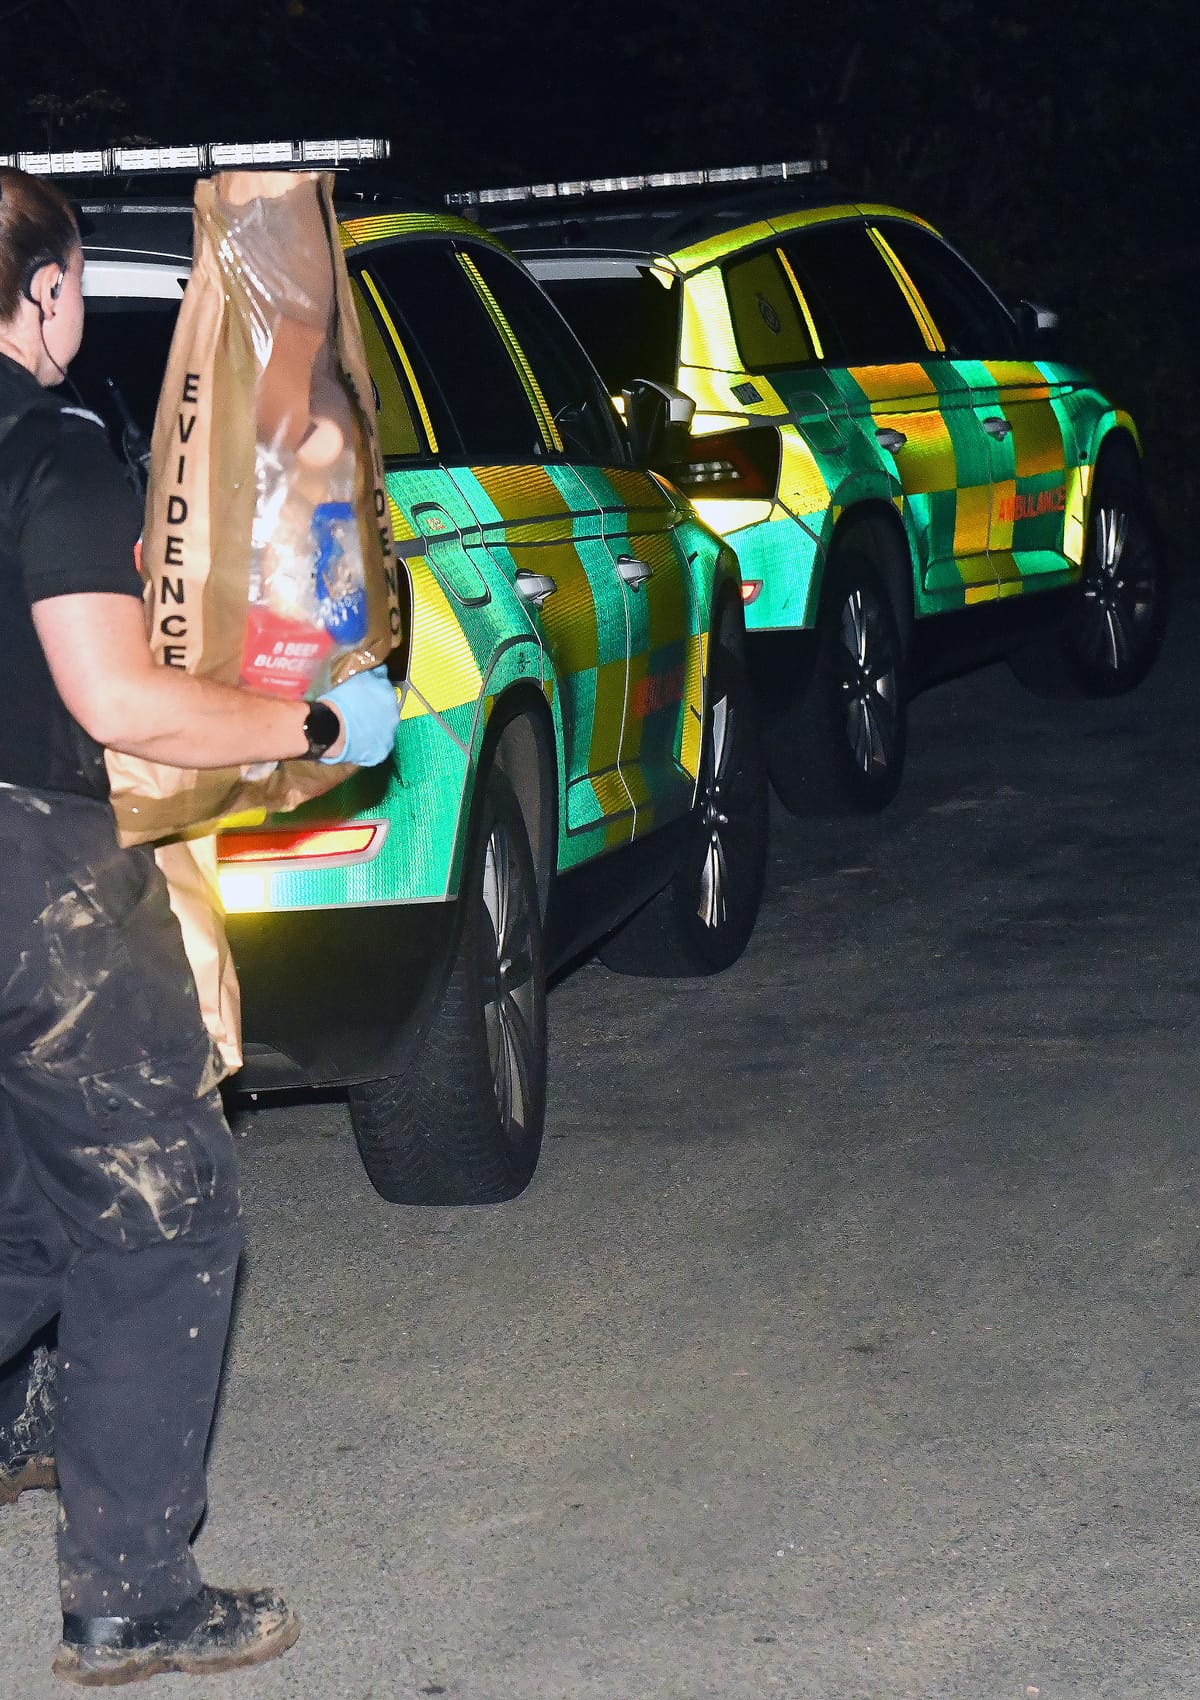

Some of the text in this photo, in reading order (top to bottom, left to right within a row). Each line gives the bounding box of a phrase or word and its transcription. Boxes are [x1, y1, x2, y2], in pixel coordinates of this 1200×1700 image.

[160, 373, 201, 672] EVIDENCE
[284, 642, 319, 657] BEEF
[253, 653, 312, 672] BURGE
